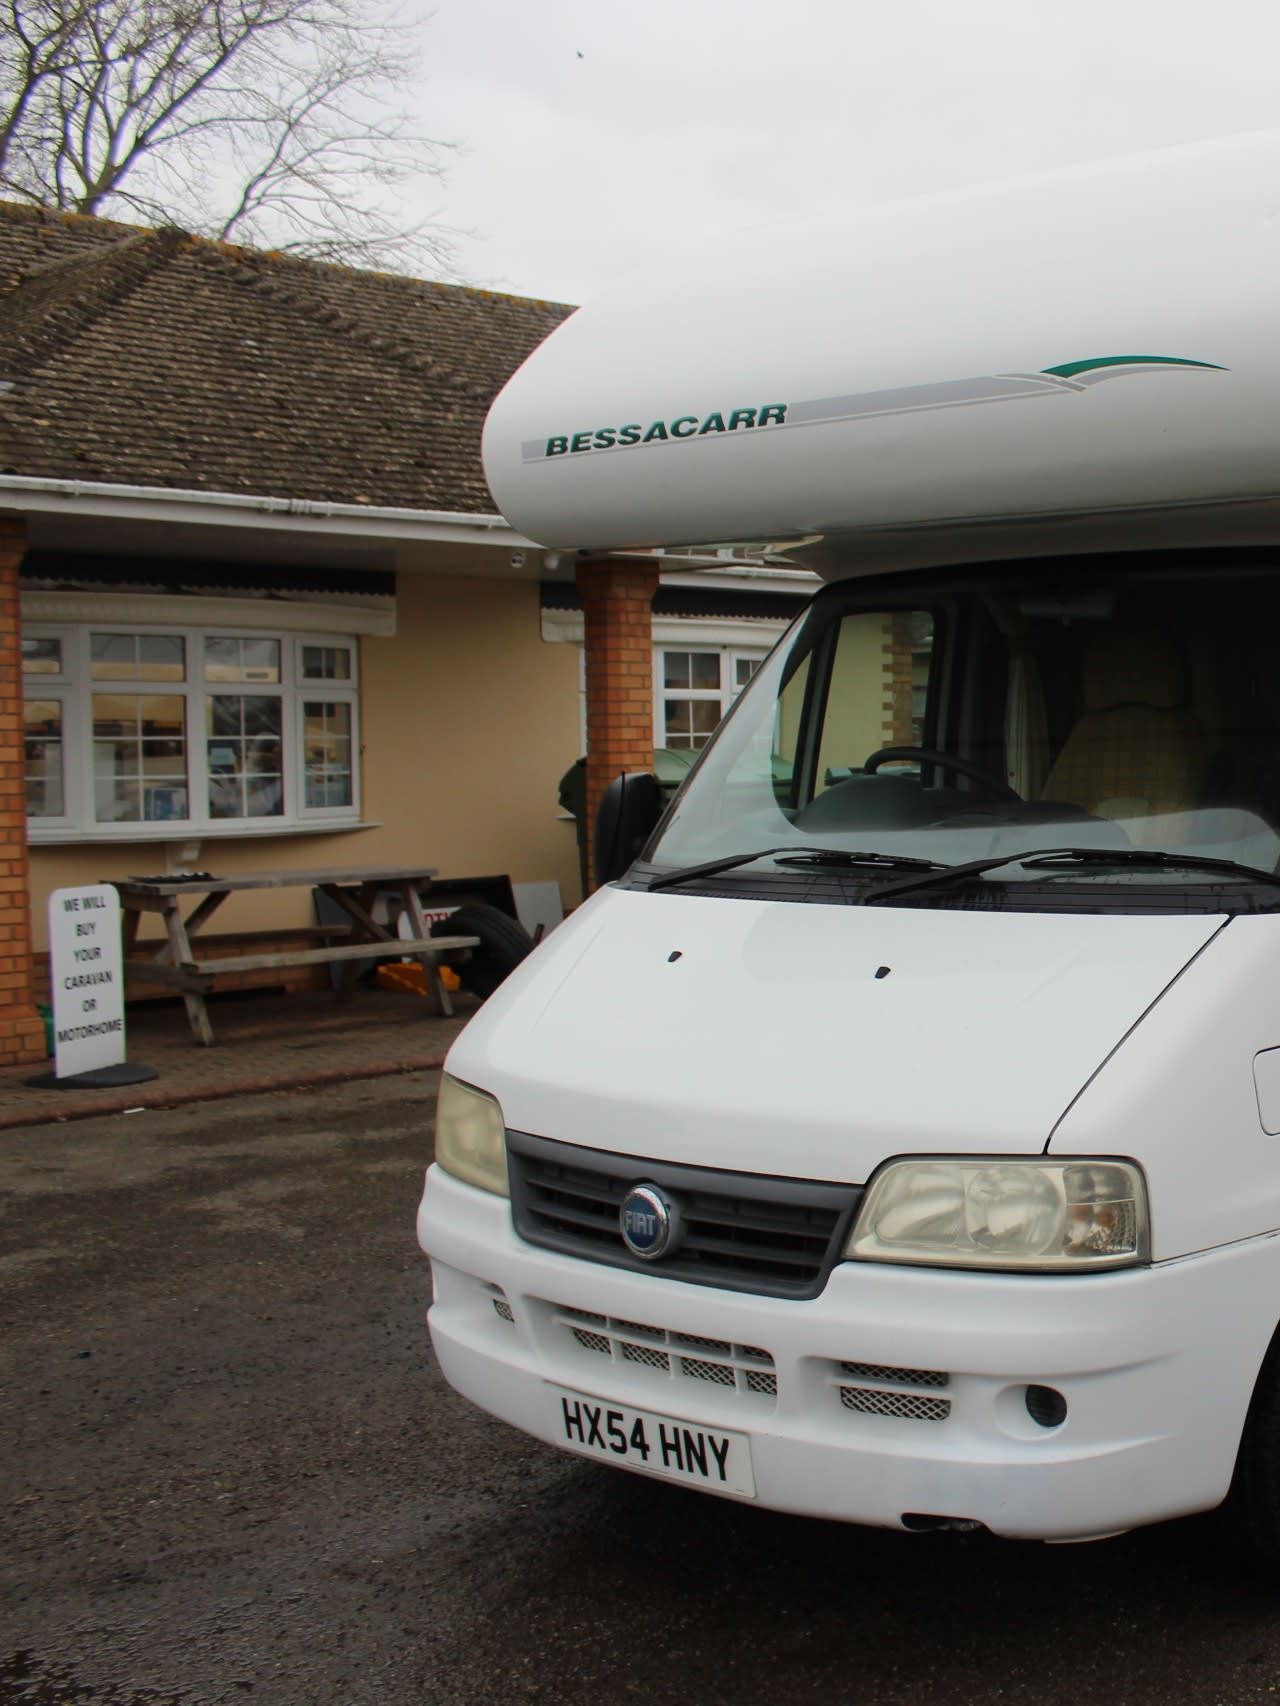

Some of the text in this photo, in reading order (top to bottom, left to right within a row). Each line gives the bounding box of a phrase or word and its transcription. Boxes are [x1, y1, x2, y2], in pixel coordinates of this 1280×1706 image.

[545, 402, 788, 458] BESSACARR
[63, 896, 106, 912] WE WILL
[75, 922, 96, 937] BUY
[72, 947, 102, 962] YOUR
[63, 970, 113, 991] CARAVAN
[82, 999, 97, 1012] OR
[57, 1018, 123, 1043] MOTORHOME
[624, 1210, 657, 1236] FIAT
[561, 1397, 729, 1481] HX54 HNY
